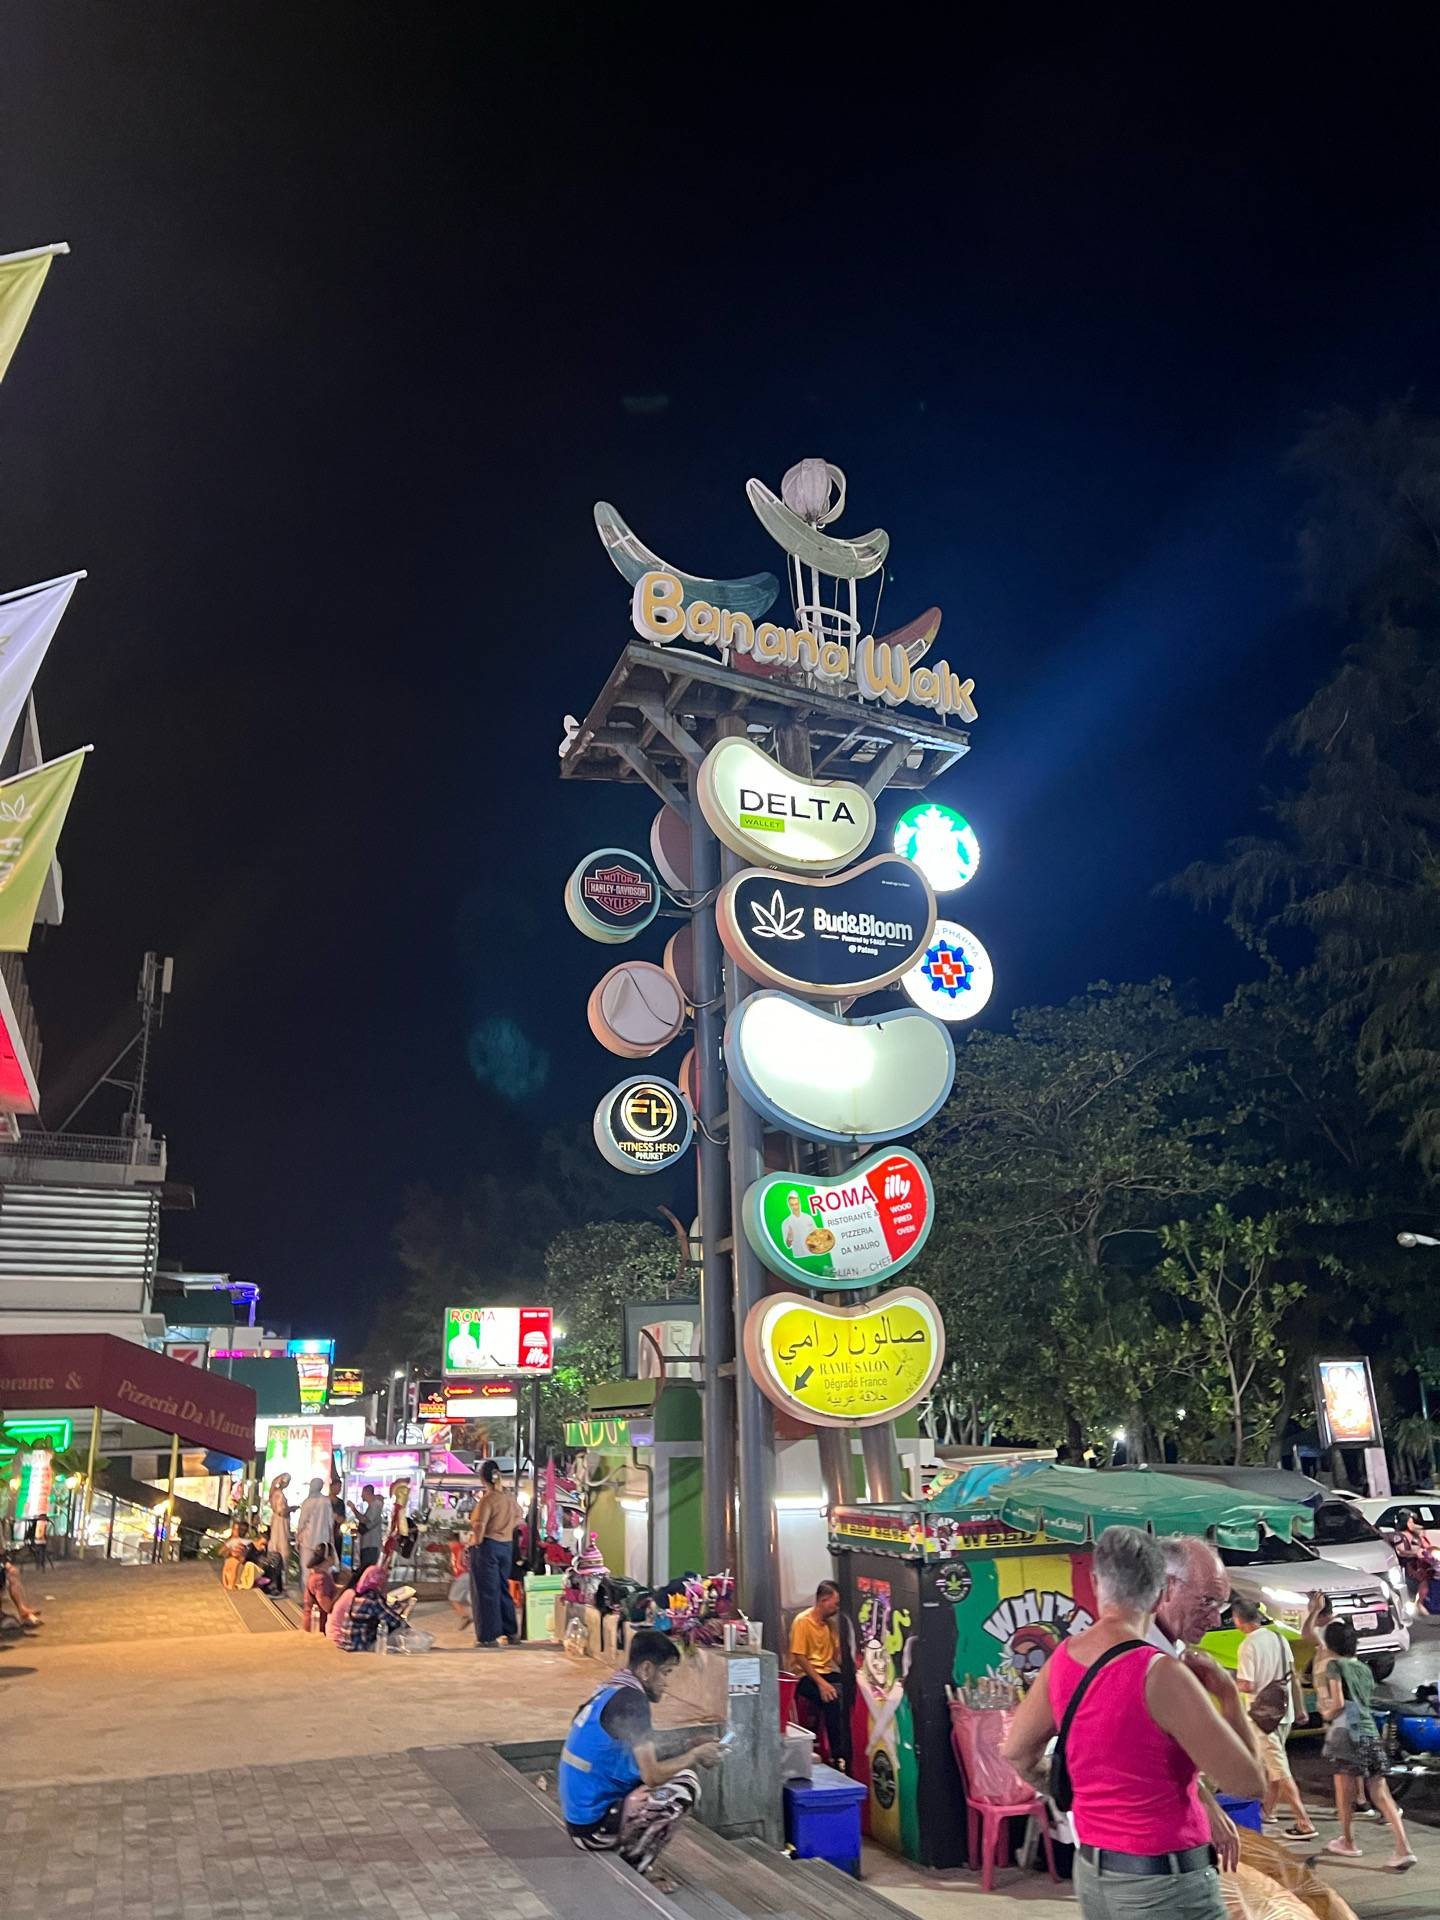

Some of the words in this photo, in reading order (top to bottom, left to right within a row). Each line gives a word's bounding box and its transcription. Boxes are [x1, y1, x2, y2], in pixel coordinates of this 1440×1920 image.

[633, 571, 849, 681] Banana
[856, 634, 979, 722] Walk
[740, 789, 856, 825] DELTA
[744, 818, 781, 829] WALLET
[603, 872, 635, 883] MOTOR
[590, 882, 647, 897] HARLEY-DAVIDSON
[813, 907, 913, 941] Bud&Bloom
[619, 1142, 655, 1153] FITNESS
[655, 1142, 680, 1153] HERO
[635, 1152, 664, 1161] PHUKET
[884, 1174, 911, 1200] illy
[809, 1185, 876, 1215] ROMA
[889, 1202, 912, 1214] WOOD
[827, 1211, 873, 1228] RISTORANTE
[893, 1213, 913, 1225] FIRED
[841, 1226, 874, 1239] PIZZERIA
[896, 1224, 916, 1236] OVEN
[841, 1247, 853, 1255] DA
[853, 1240, 881, 1252] MAURO
[450, 1310, 496, 1323] ROMA
[777, 1319, 839, 1366] رامي
[847, 1315, 926, 1356] صالون
[855, 1360, 890, 1374] SALON
[65, 1371, 83, 1390] &
[824, 1376, 859, 1391] Dégradé
[860, 1376, 888, 1387] France
[117, 1379, 178, 1417] Pizzeria
[180, 1400, 204, 1424] Da
[269, 1428, 310, 1440] ROMA
